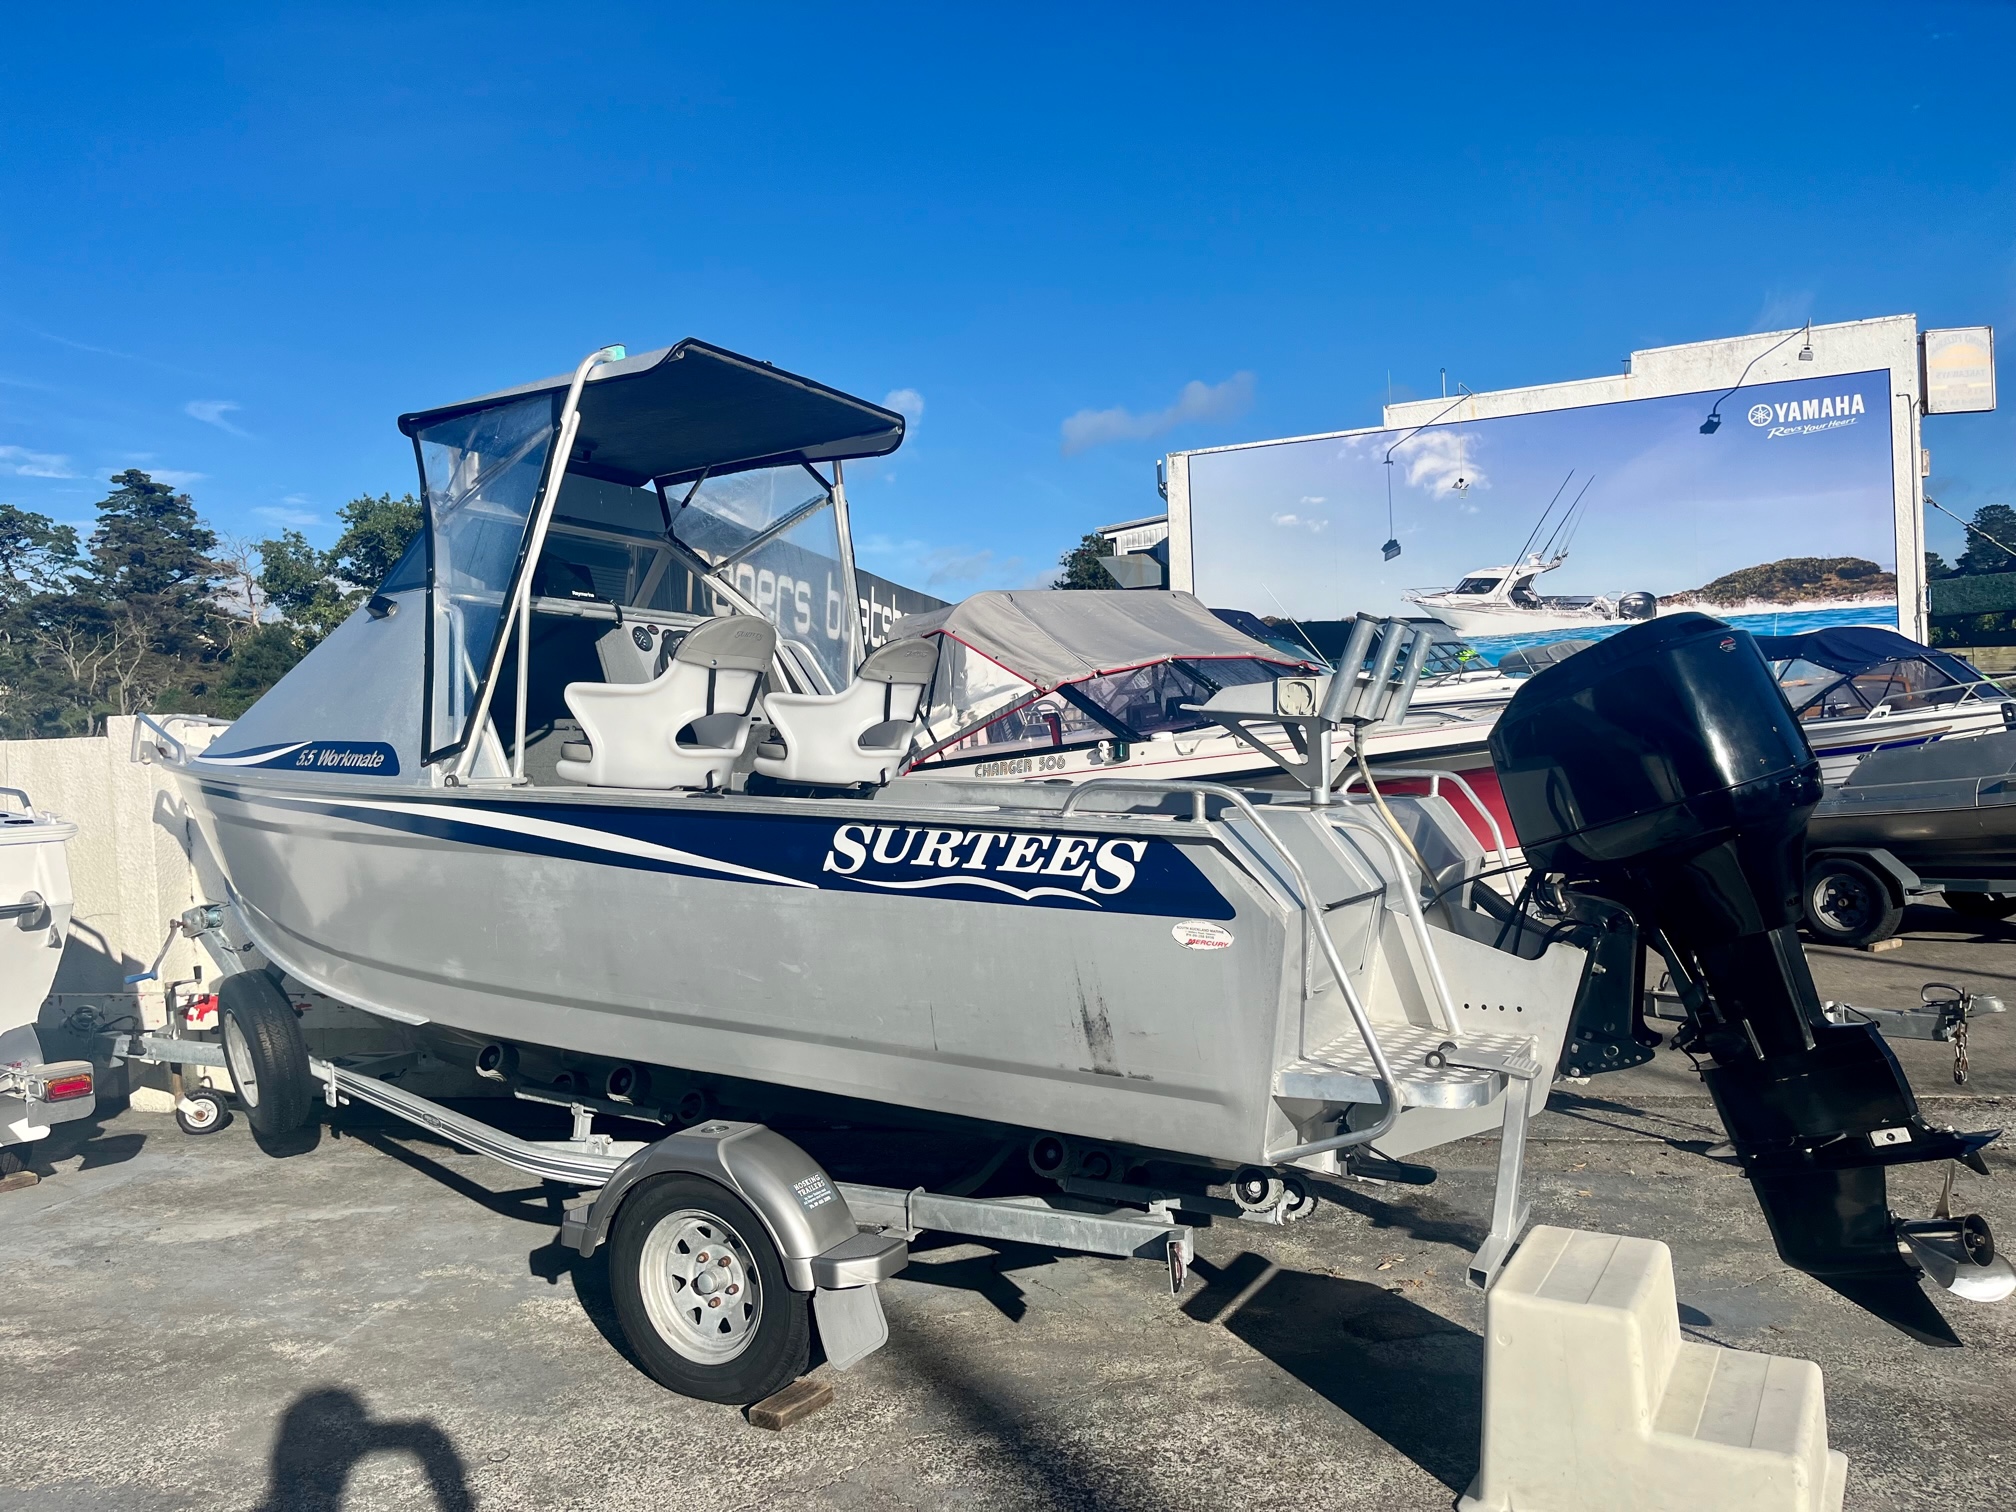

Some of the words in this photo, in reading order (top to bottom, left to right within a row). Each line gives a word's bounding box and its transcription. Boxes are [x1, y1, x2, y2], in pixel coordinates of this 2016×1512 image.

[1774, 394, 1865, 423] YAMAHA
[1767, 426, 1802, 439] Revs
[1802, 422, 1828, 434] Your
[1828, 417, 1857, 427] Heart
[571, 590, 595, 598] Raymarine
[826, 572, 910, 648] batsh
[295, 749, 317, 766] 5.5
[317, 749, 385, 768] Workmate
[1038, 754, 1066, 772] 506
[822, 823, 1149, 896] SURTEES
[1187, 938, 1229, 947] MERCURY
[793, 1174, 821, 1191] HOSKING
[797, 1180, 826, 1197] TRAILERS
